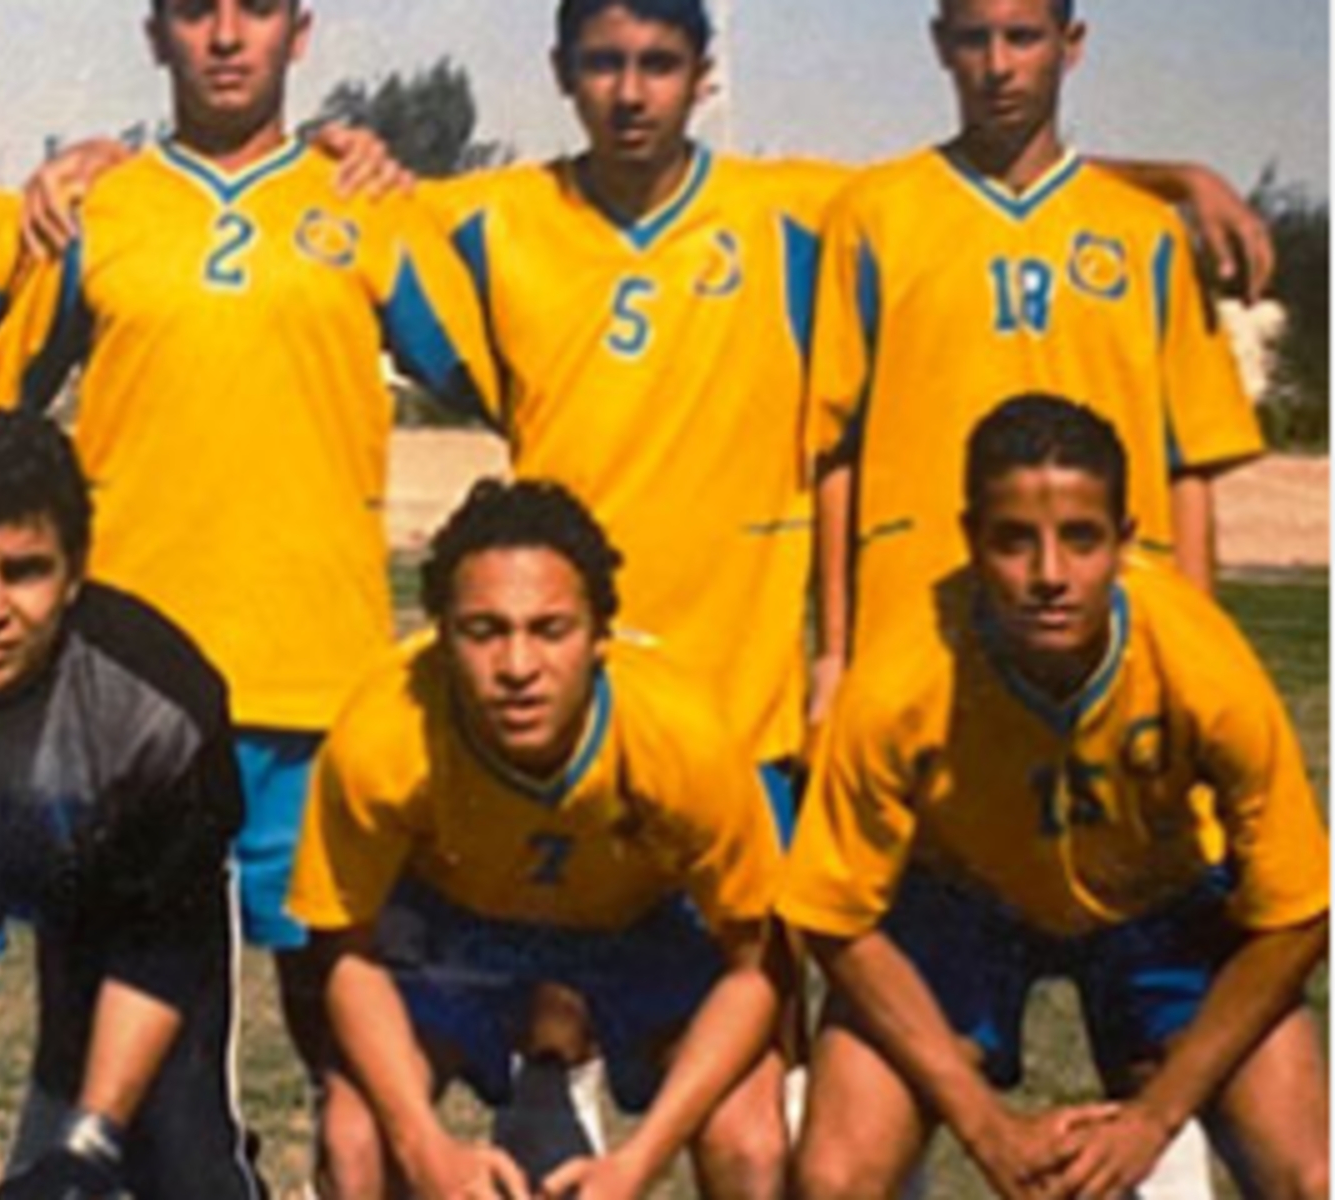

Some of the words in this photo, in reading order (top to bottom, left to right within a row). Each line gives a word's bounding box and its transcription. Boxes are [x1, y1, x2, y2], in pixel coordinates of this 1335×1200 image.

[203, 211, 256, 288] 2
[605, 276, 657, 355] 5
[990, 255, 1053, 335] 18
